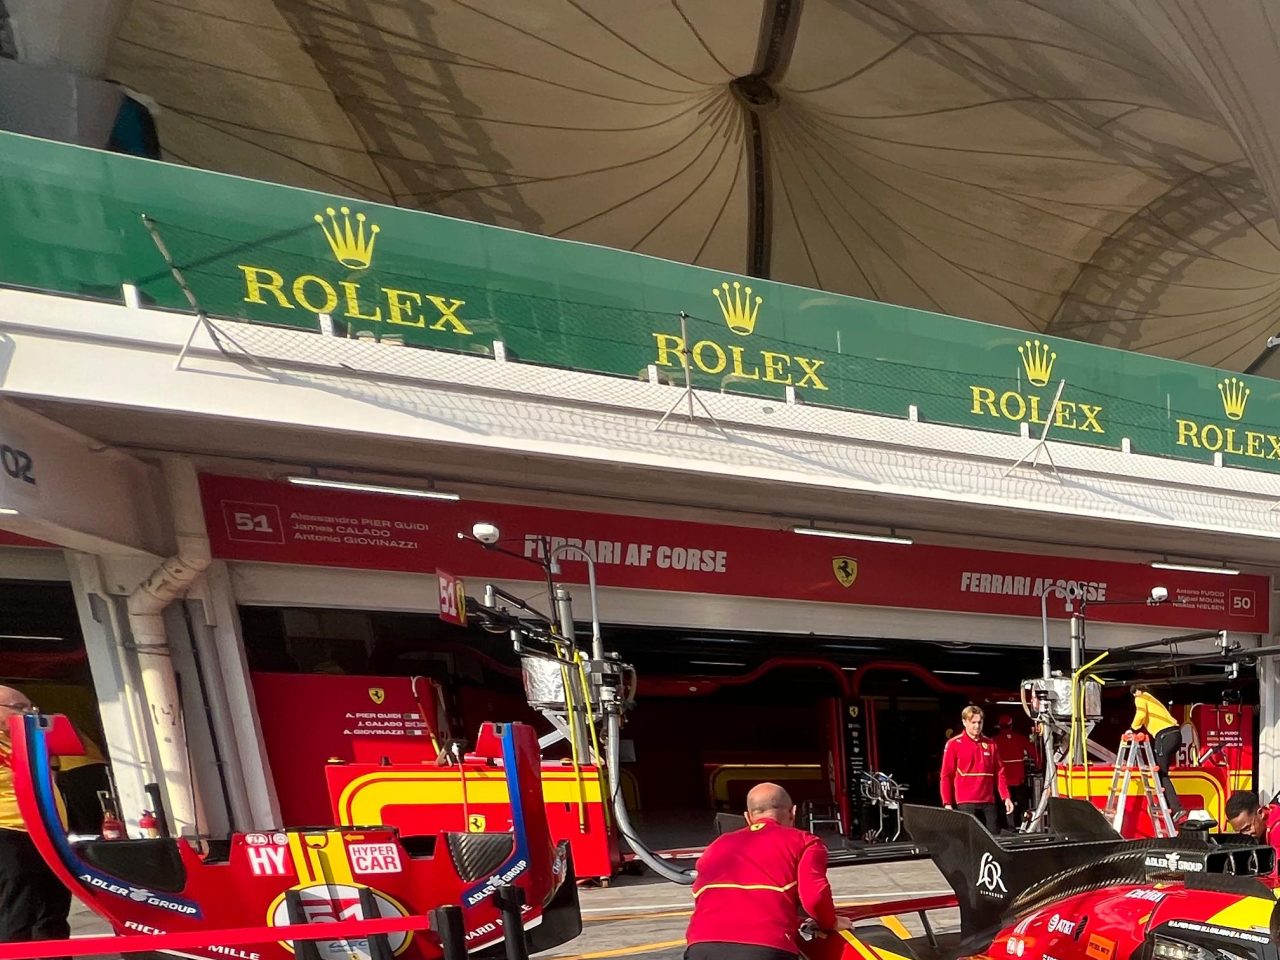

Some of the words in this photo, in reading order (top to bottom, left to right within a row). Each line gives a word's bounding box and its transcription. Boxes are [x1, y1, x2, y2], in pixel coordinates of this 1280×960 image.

[237, 264, 473, 335] ROLEX
[651, 332, 829, 391] ROLEX
[969, 385, 1105, 434] ROLEX
[0, 444, 37, 486] 02
[234, 512, 273, 533] 51
[292, 524, 334, 533] James
[335, 526, 391, 537] CALADO
[361, 518, 391, 528] PIER
[394, 521, 429, 531] GUIDI
[343, 536, 418, 549] GIOVINAZZI
[524, 534, 621, 564] FERRARI
[625, 543, 652, 567] AF
[656, 546, 727, 573] CORSE
[439, 575, 457, 617] 51
[961, 572, 1031, 597] FERRARI
[1233, 596, 1251, 609] 50
[247, 846, 287, 875] HY
[352, 845, 395, 857] HYPER
[355, 856, 398, 871] CAR
[1145, 856, 1168, 868] ADLER
[1178, 861, 1204, 872] GROUP
[79, 874, 128, 897] ADLER
[147, 897, 198, 915] GROUP
[467, 885, 497, 905] ADLER
[502, 860, 527, 882] GROUP
[1055, 918, 1076, 936] AT&T
